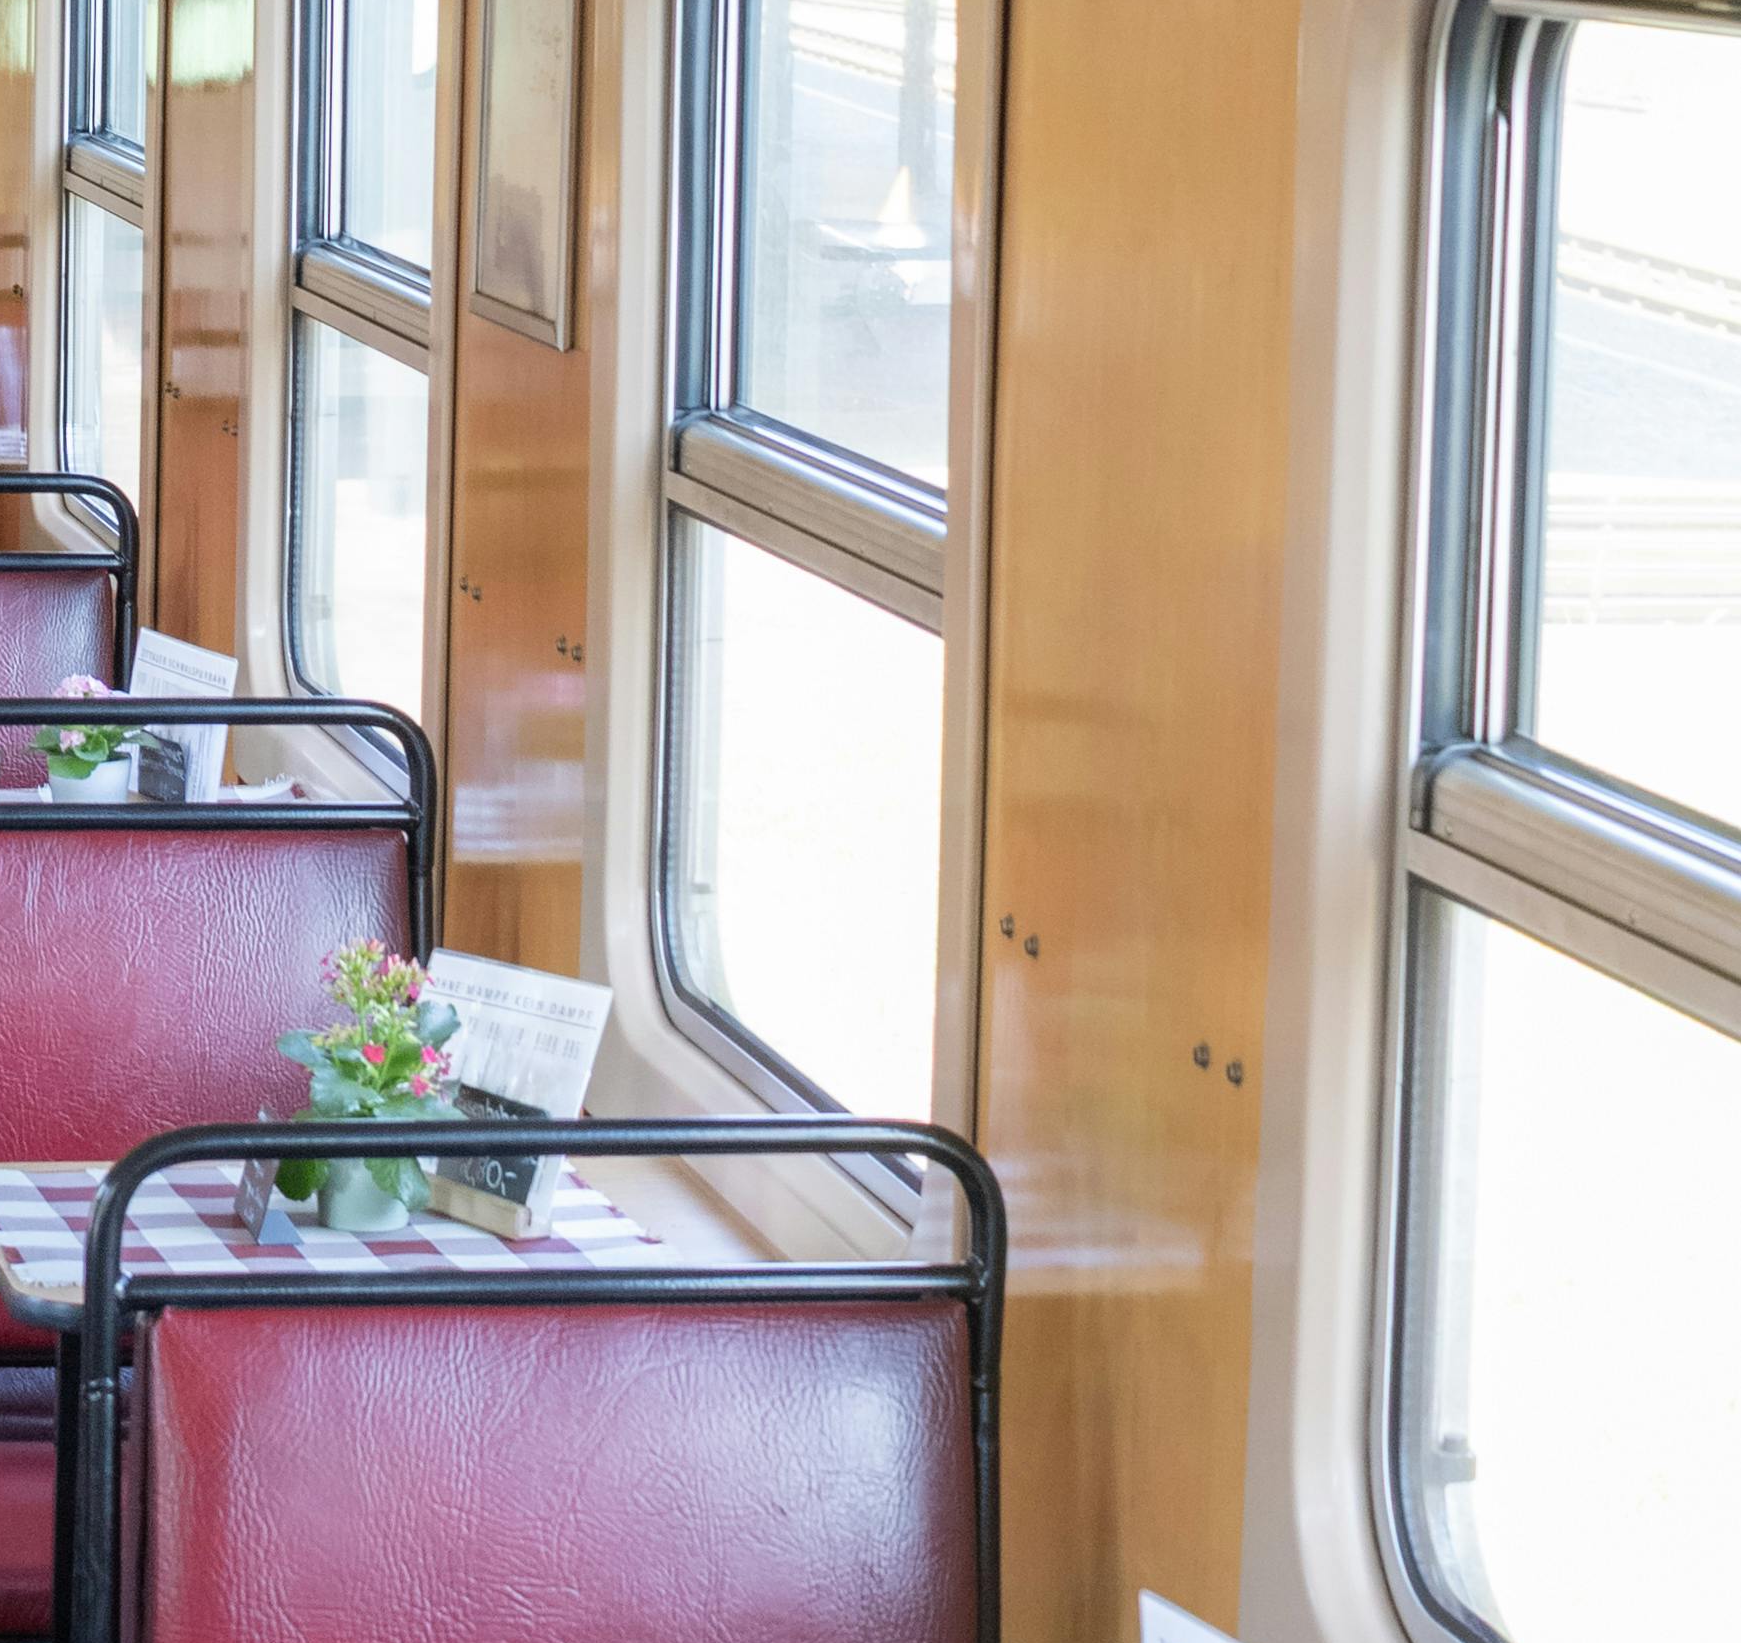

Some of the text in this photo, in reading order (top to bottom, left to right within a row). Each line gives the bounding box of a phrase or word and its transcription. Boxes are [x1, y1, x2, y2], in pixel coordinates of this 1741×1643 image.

[466, 984, 510, 1002] MAMPF
[514, 995, 544, 1012] KEIN
[548, 1001, 596, 1022] DAMPF
